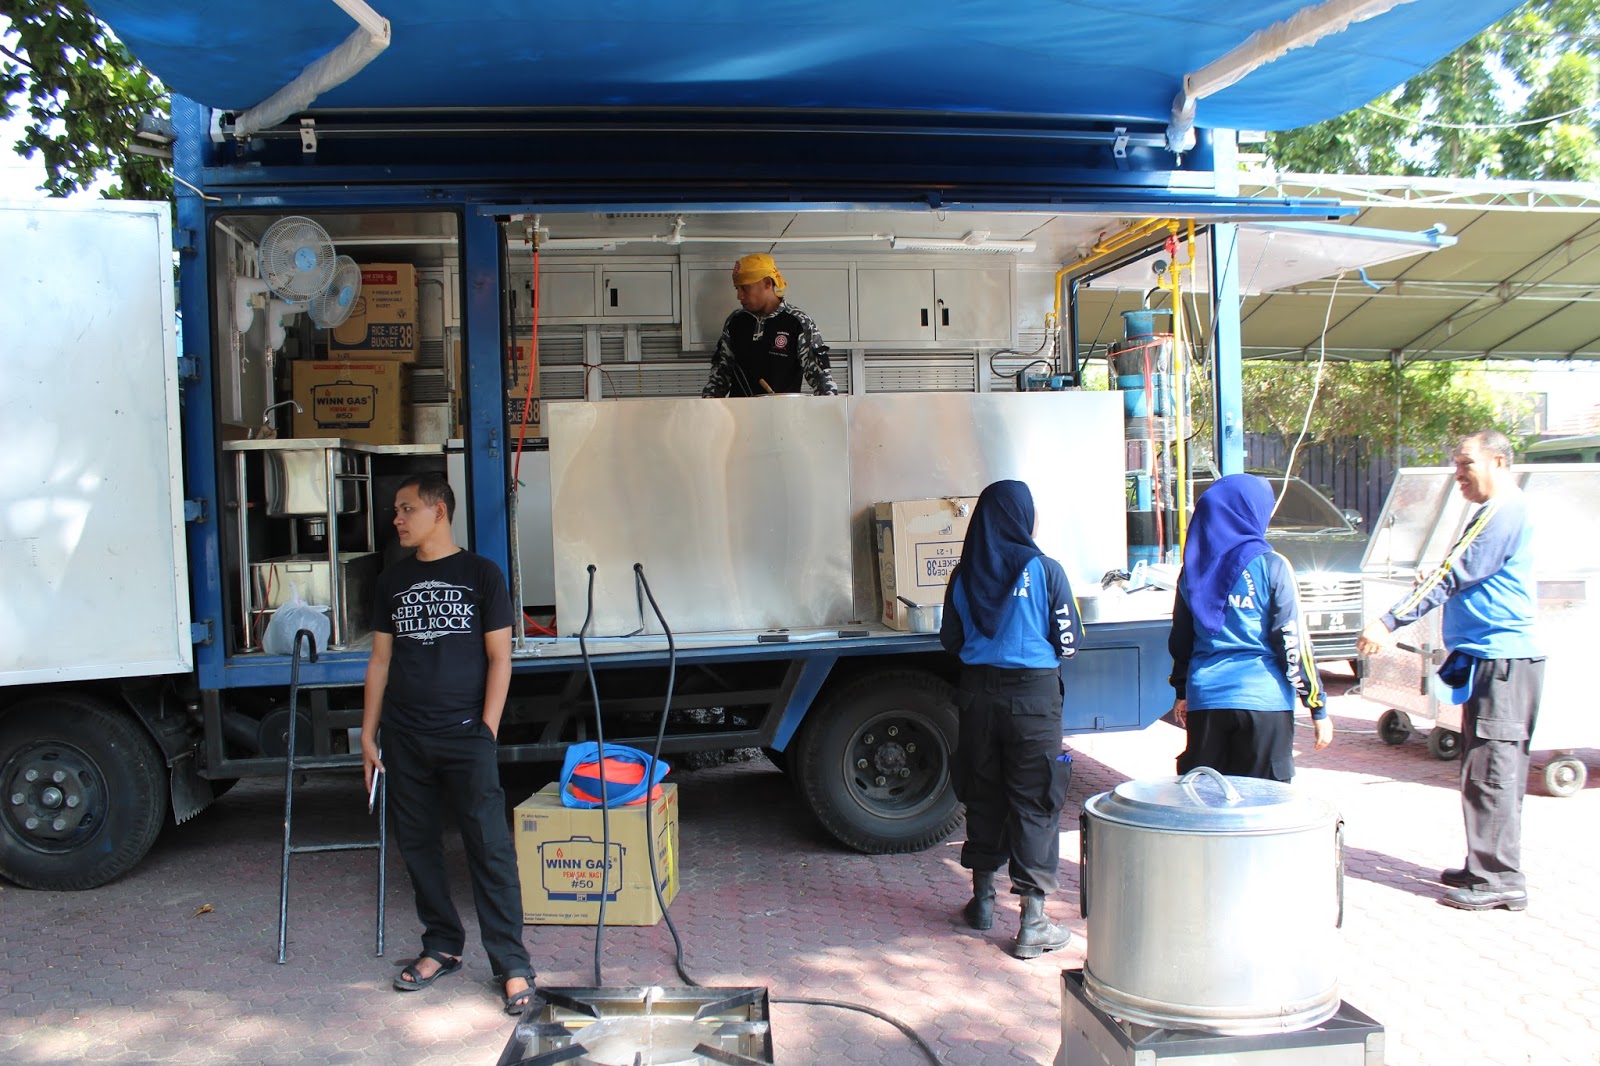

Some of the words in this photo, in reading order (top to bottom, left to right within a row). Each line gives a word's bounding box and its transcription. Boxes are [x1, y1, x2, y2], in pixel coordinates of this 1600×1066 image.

[371, 326, 385, 335] RICE
[389, 325, 399, 335] ICE
[400, 325, 412, 347] 38
[371, 337, 398, 347] BUCKET
[316, 397, 344, 405] WINN
[346, 397, 368, 405] GAS
[926, 559, 937, 577] 38
[937, 559, 961, 568] CKET
[937, 568, 948, 576] ICE
[426, 603, 475, 617] WORK
[428, 616, 472, 629] ROCK
[1055, 603, 1076, 657] TAGA
[545, 859, 582, 869] WINN
[570, 880, 594, 889] #50
